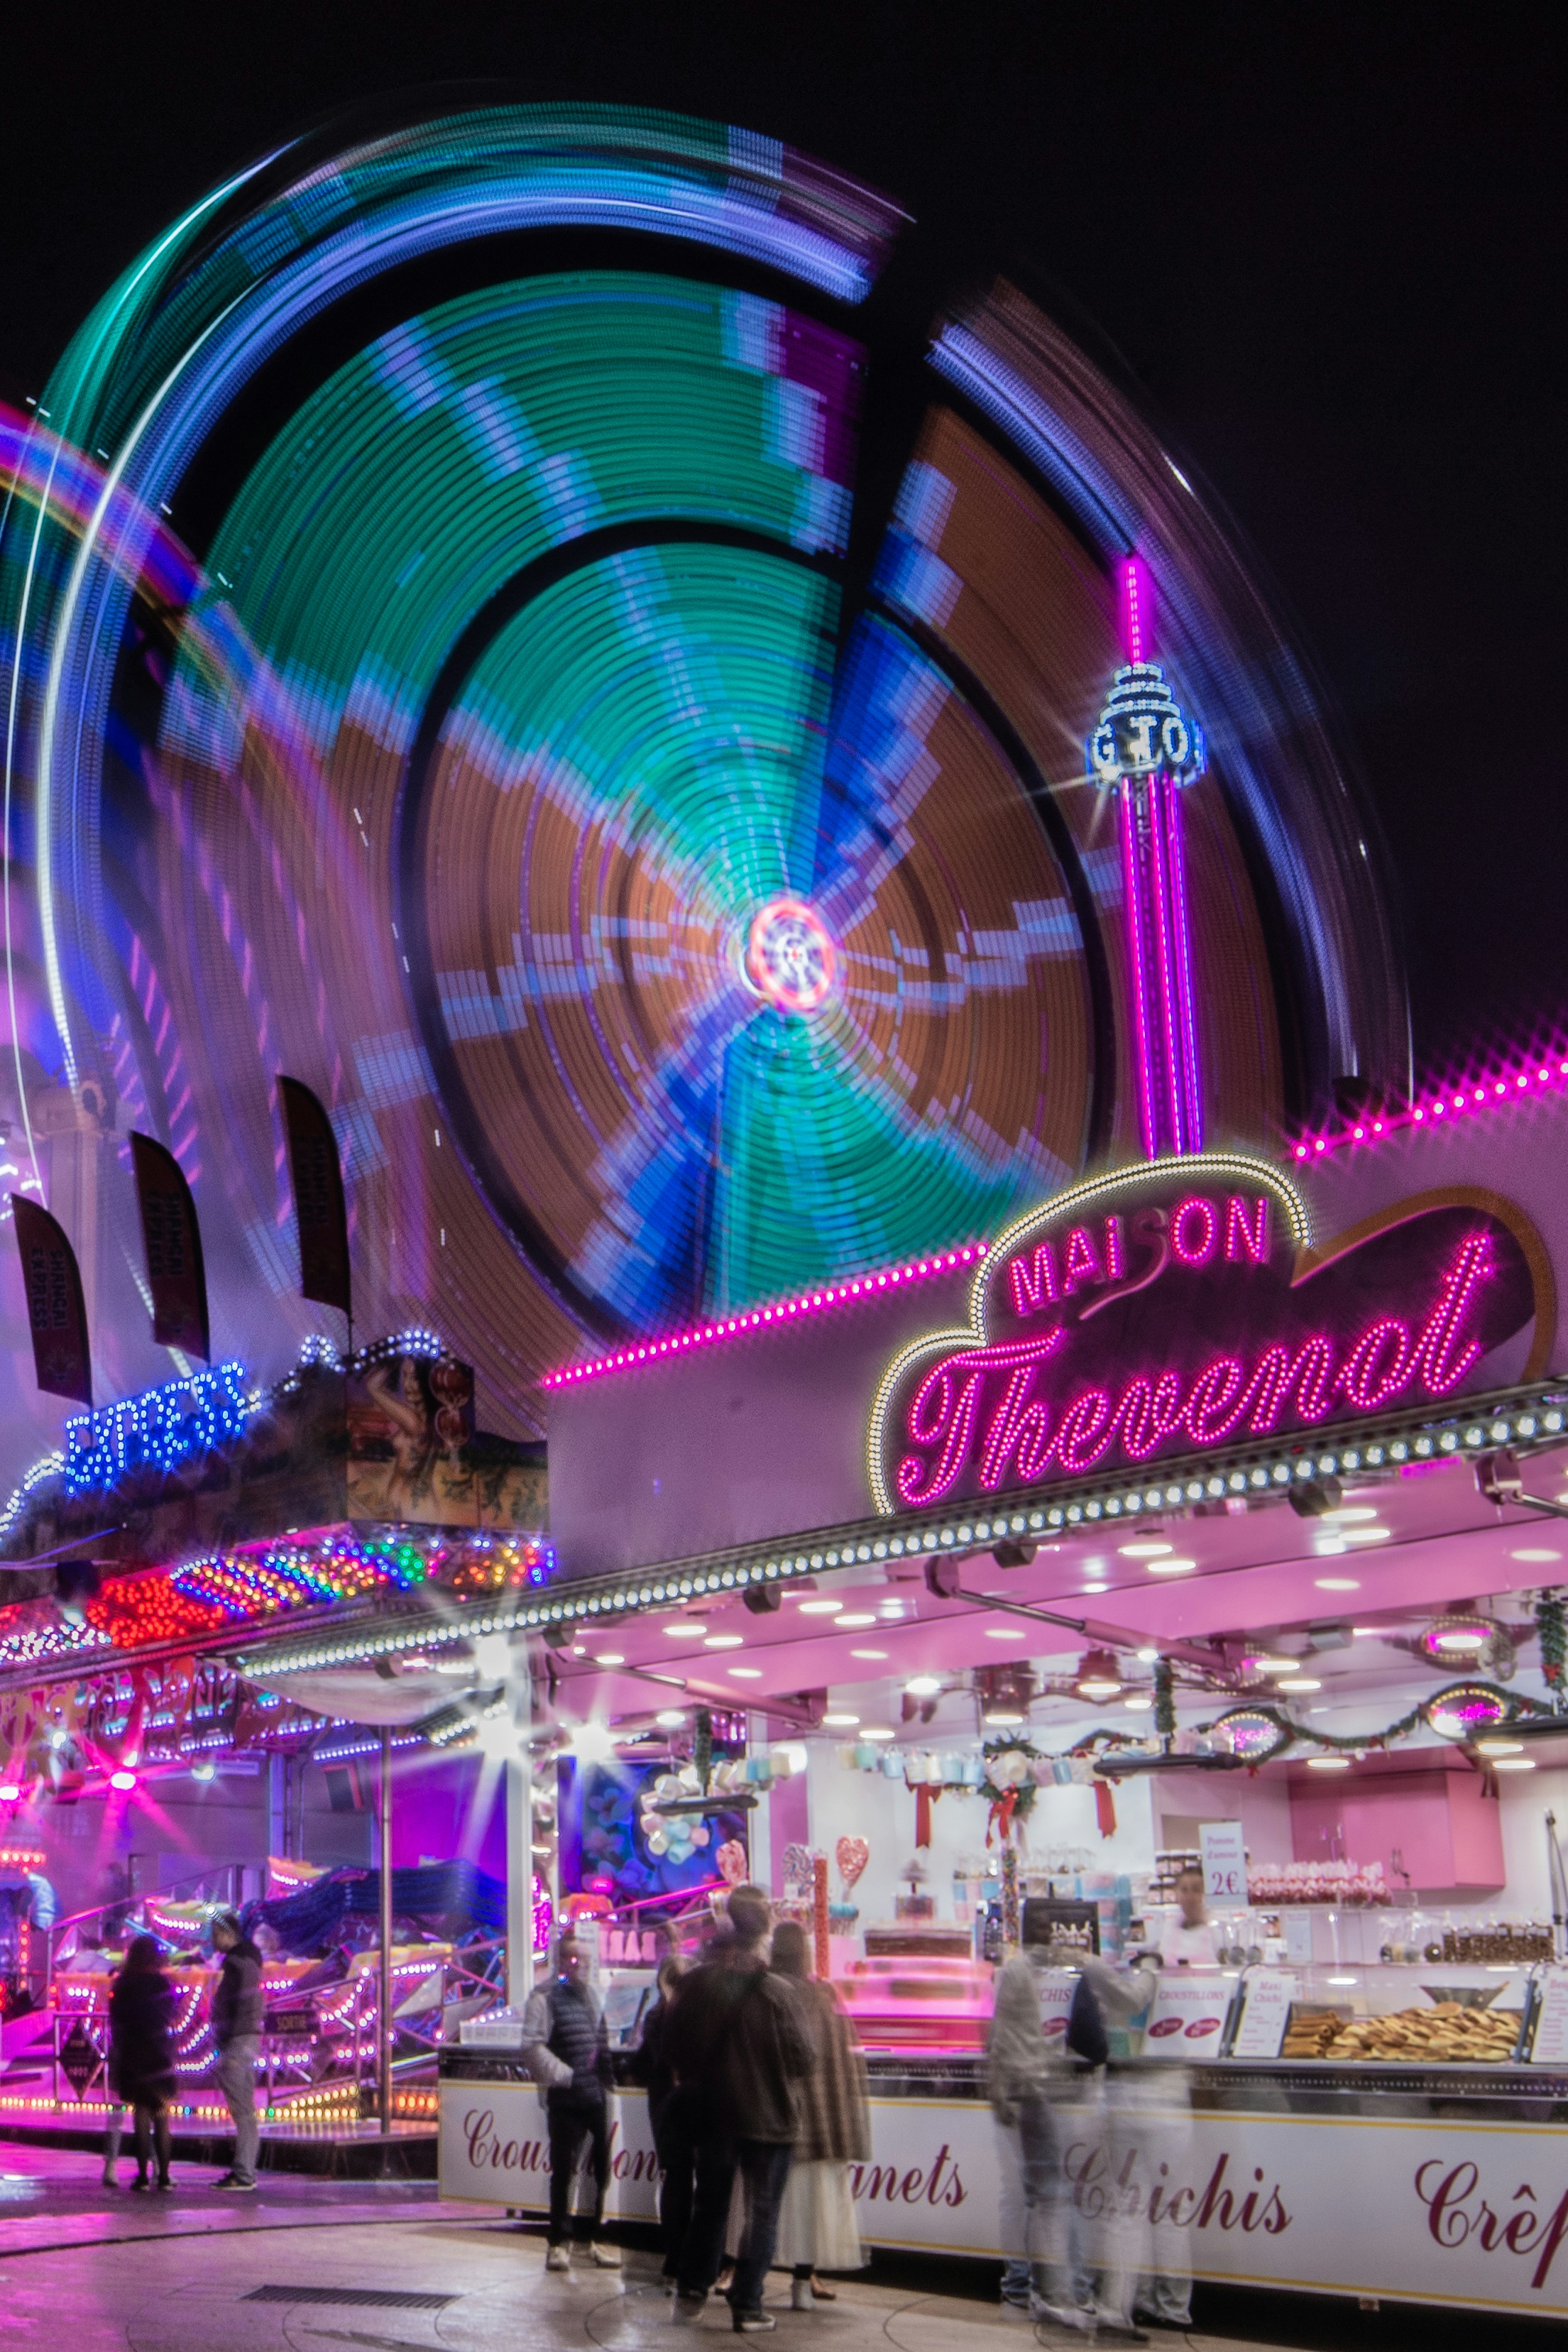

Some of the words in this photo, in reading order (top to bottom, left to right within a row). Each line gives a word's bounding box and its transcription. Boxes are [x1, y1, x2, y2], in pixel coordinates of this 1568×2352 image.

[1091, 714, 1189, 770] GTO
[31, 1245, 48, 1328] EXPRESS
[50, 1249, 68, 1328] SHANGAI
[1006, 1195, 1269, 1320] MAISON
[895, 1231, 1495, 1506] Thevenot
[65, 1361, 245, 1494] EXPRESS
[1212, 1870, 1240, 1896] 2€
[1038, 1988, 1073, 2002] CHIS
[1064, 2142, 1293, 2234] Chichis
